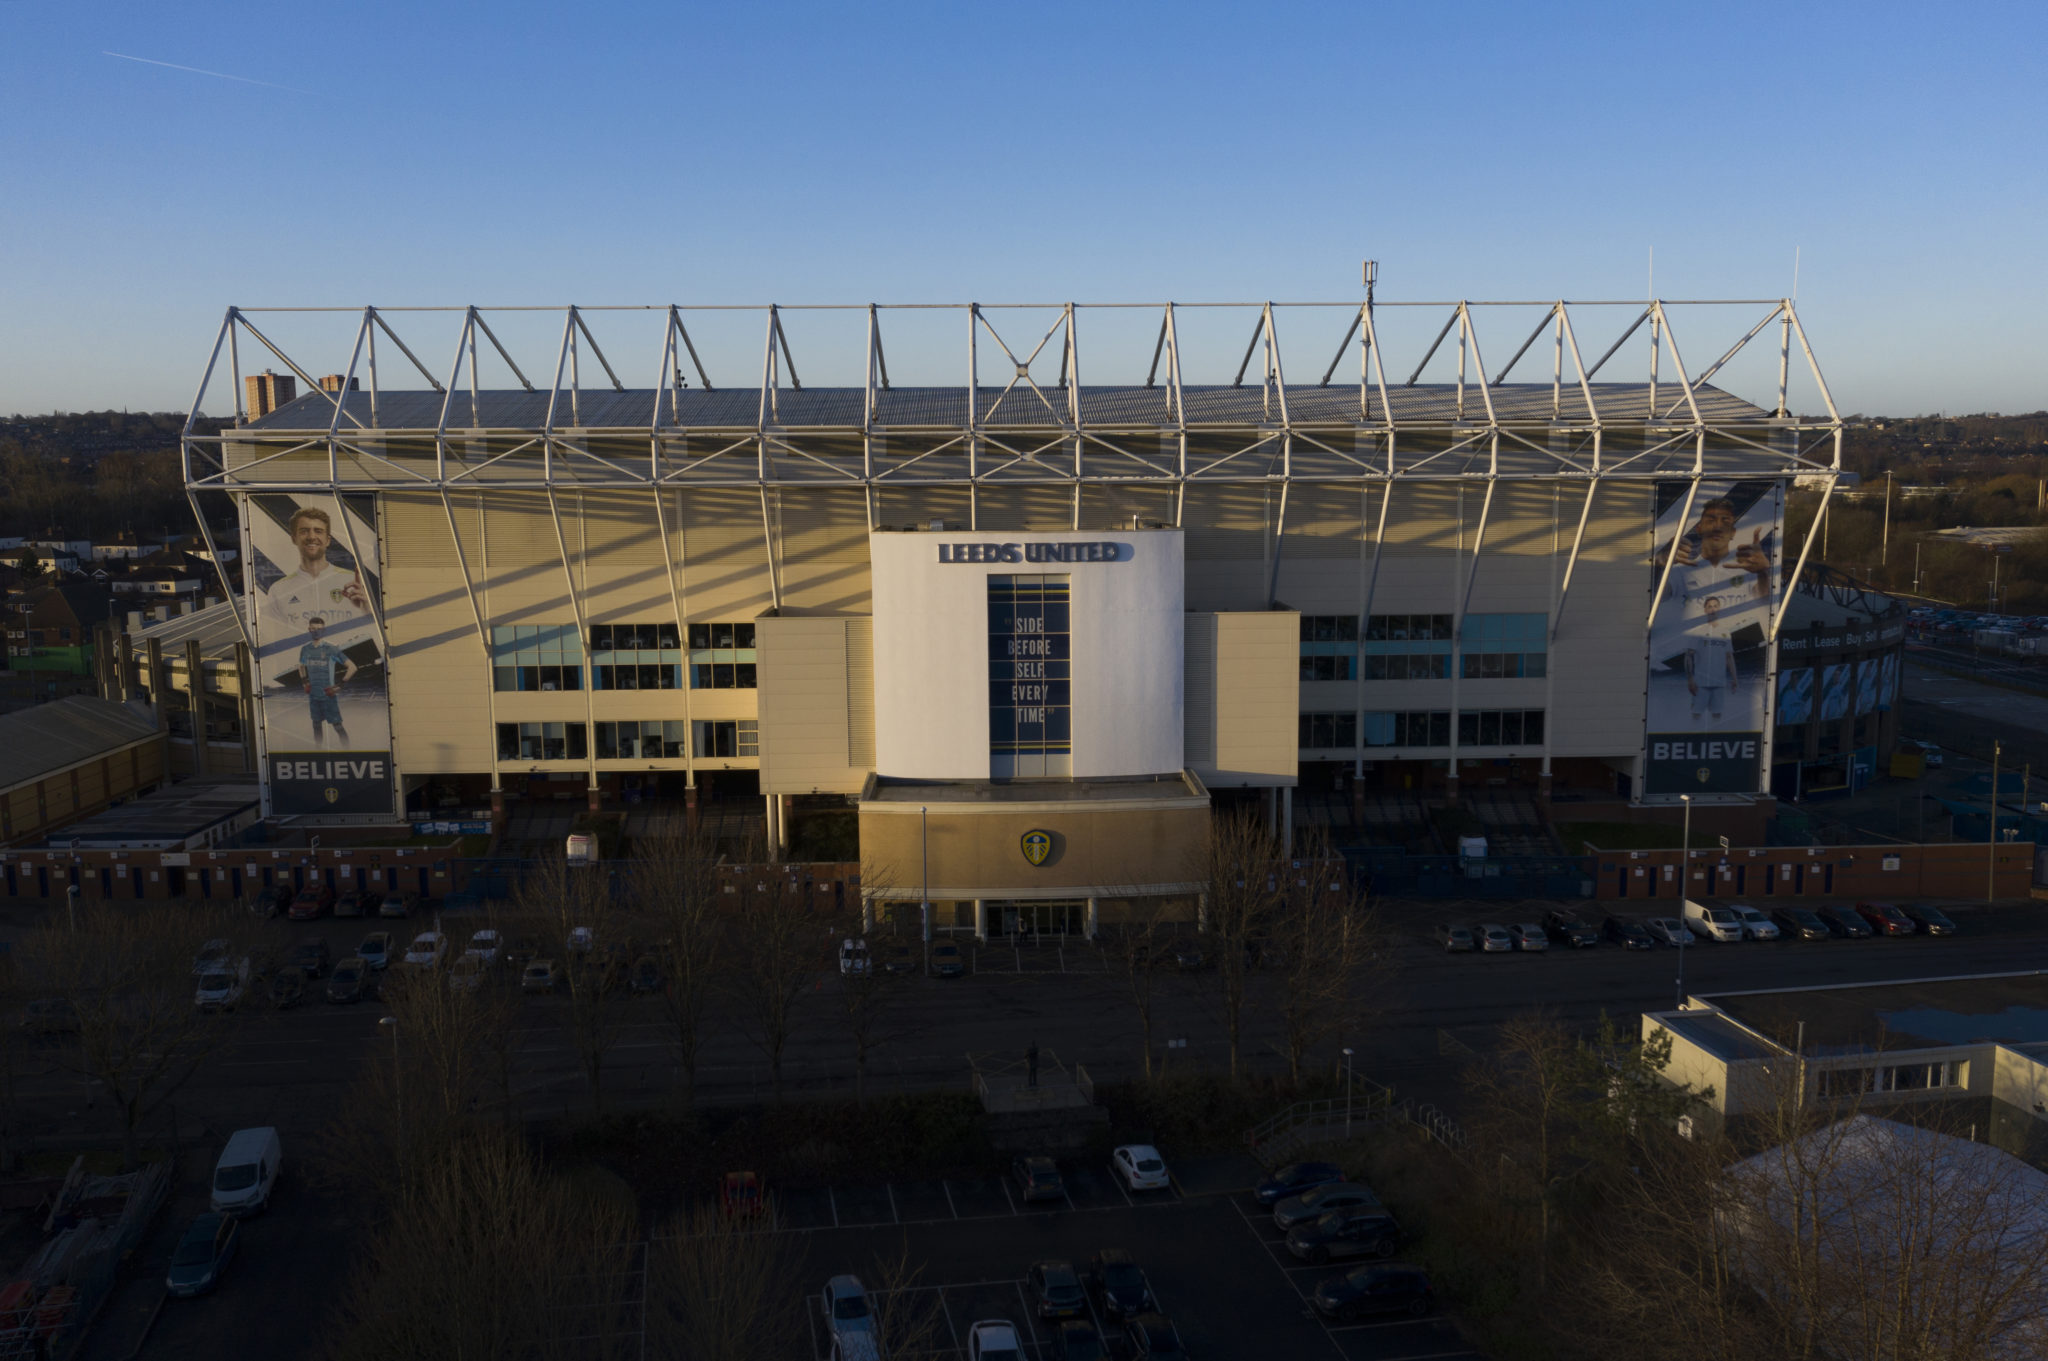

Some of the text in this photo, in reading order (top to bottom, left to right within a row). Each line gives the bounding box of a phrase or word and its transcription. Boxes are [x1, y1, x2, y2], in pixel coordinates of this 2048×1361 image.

[938, 542, 1119, 563] LEEDS UNITED
[1008, 640, 1052, 655] BEFORE
[1782, 638, 1807, 650] Rent
[1814, 636, 1840, 648] Lease
[1012, 685, 1049, 700] EVERY
[1653, 741, 1756, 760] BELIEVE
[276, 761, 385, 780] BELIEVE
